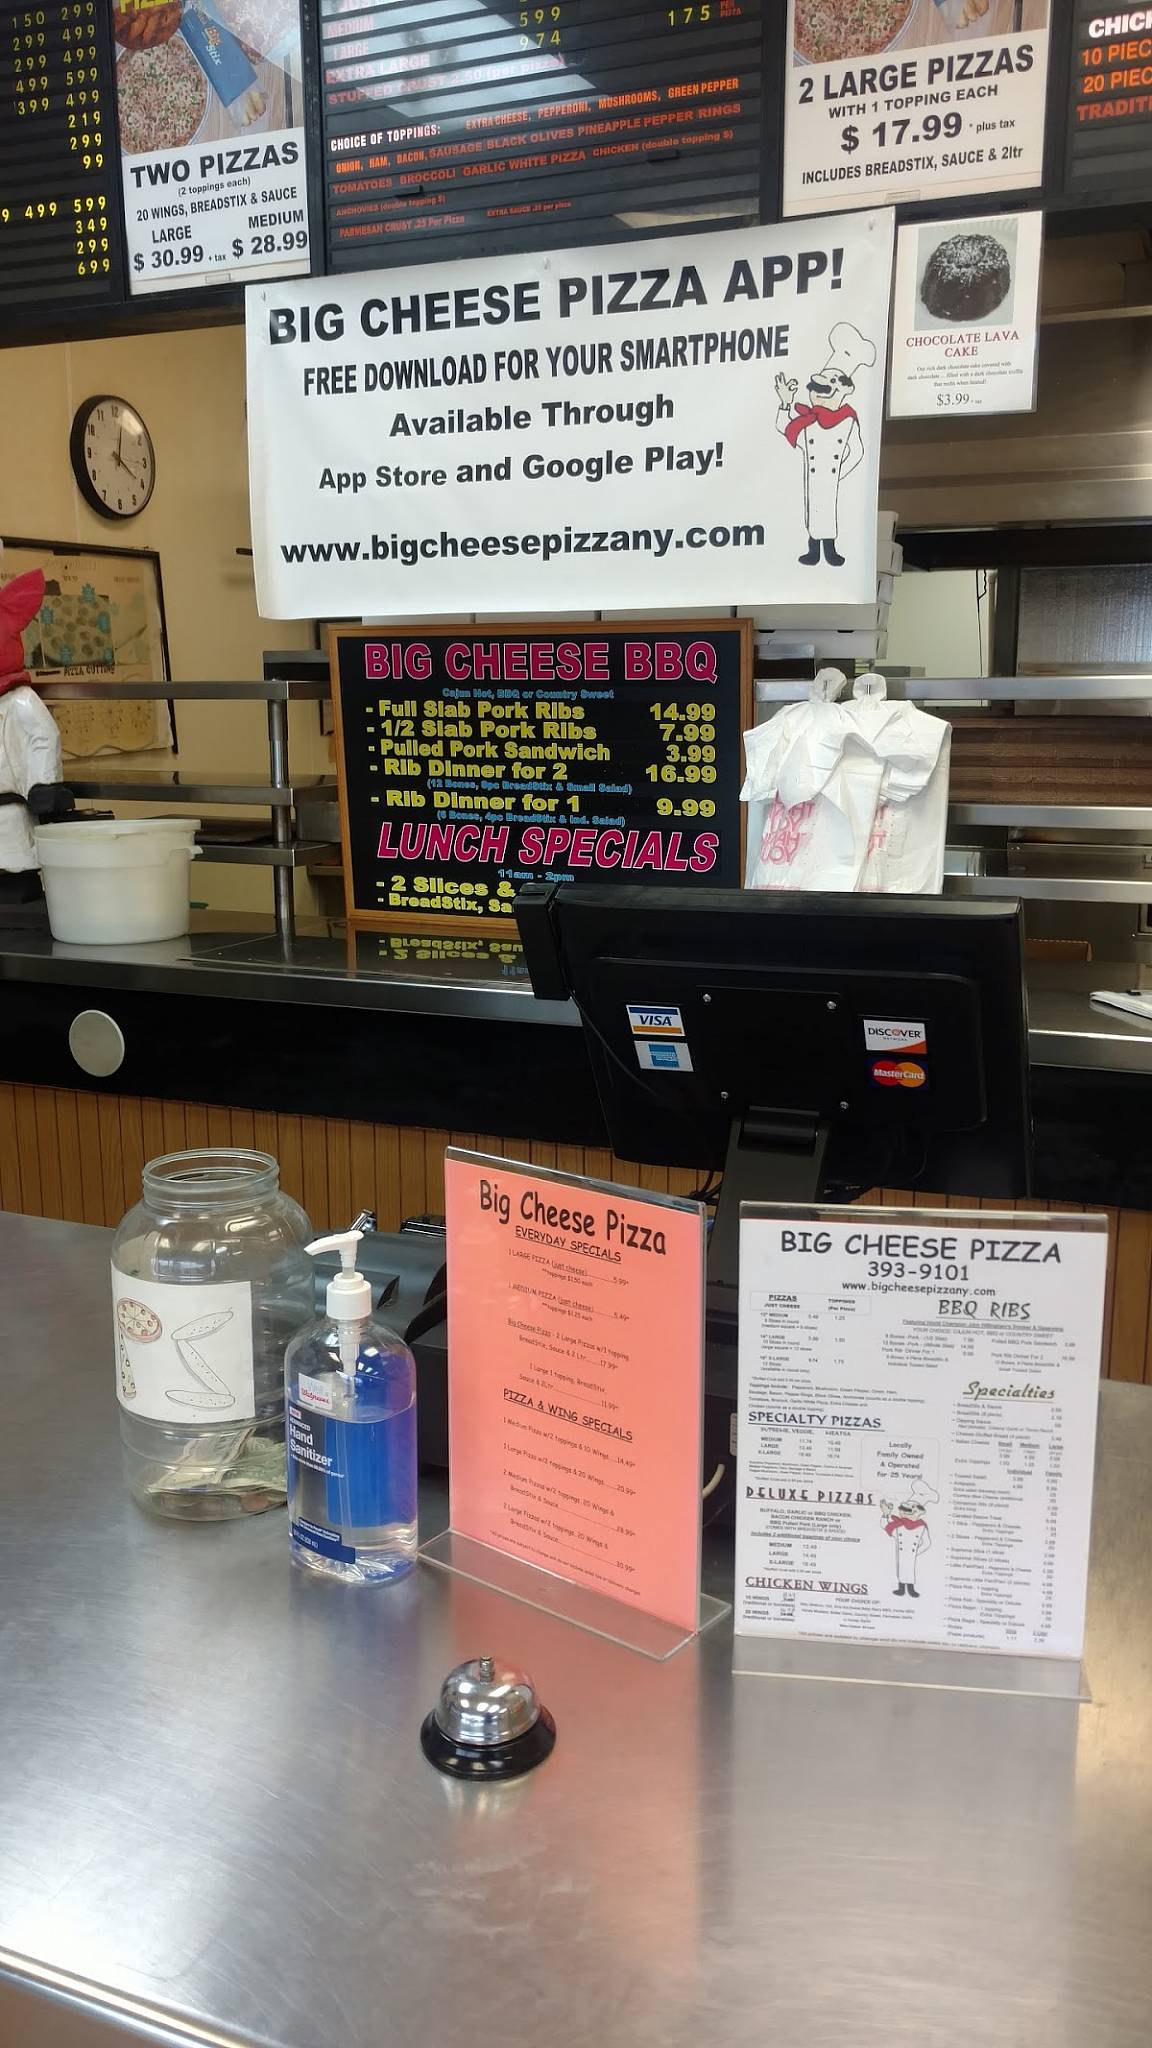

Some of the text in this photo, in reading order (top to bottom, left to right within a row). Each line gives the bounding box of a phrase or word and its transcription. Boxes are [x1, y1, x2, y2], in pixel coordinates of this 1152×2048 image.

[520, 5, 710, 27] 599 175
[64, 47, 96, 64] 499
[1083, 47, 1102, 66] 10
[66, 68, 98, 86] 599
[799, 44, 1034, 104] 2 LARGE PIZZAS
[1083, 75, 1105, 93] 20
[829, 84, 998, 119] WITH 1 TOPPING EACH
[68, 111, 101, 128] 219
[331, 78, 739, 151] CHOICE OF TOPPINGS: EXTRA GREEN PEPPER
[428, 103, 741, 158] SAUSAGE BLACK OLIVES PINEAPPLE PEPPER RINGS
[872, 112, 1016, 148] 17.99 plus tax
[70, 133, 102, 150] 299
[130, 141, 299, 188] TWO PIZZAS
[332, 132, 720, 194] TOMATOES BROCCOLI GARLIC WHITE PIZZA CHICKEN topping
[802, 149, 984, 185] INCLUDES BREADSTIX, SAUCE
[188, 176, 251, 196] toppings each)
[73, 196, 106, 213] 599
[136, 187, 297, 222] 20 WINGS, BREADSTIX & SAUCE
[76, 218, 107, 234] 349
[152, 209, 304, 244] LARGE MEDIUM
[151, 230, 308, 268] 30.99 tax 28.99
[78, 259, 110, 275] 699
[269, 248, 844, 345] BIG CHEESE PIZZA APP!
[906, 330, 1019, 348] CHOCOLATE LAVA
[304, 325, 790, 396] FREE DOWNLOAD FOR YOUR SMARTPHONE
[944, 346, 978, 358] CAKE
[936, 393, 970, 406] $3.99
[389, 394, 674, 438] Available Through
[318, 442, 724, 494] App Store and Google Play!
[281, 523, 765, 566] www.bigcheesepizzany.com
[365, 641, 718, 684] BIG CHEESE BBQ
[442, 688, 614, 700] Cajun BBQ Country Sweet
[378, 700, 716, 721] Full Slab Pork Ribs 14.99
[381, 719, 716, 742] 1/2 Slab Pork Ribs 7.99
[380, 738, 716, 763] Pulled Pork Sandwich 3.99
[384, 758, 717, 783] Rib Dinner for 2 16.99
[386, 789, 716, 817] Rib Dinner for 1 9.99
[377, 822, 719, 873] LUNCH SPECIALS
[391, 875, 488, 896] 2 Slices
[498, 869, 575, 882] 11am 2pm
[389, 893, 483, 913] BreadStix,
[638, 1015, 672, 1026] VISA
[868, 1027, 922, 1039] DISCOVER
[873, 1068, 925, 1081] MasterCard
[479, 1179, 666, 1255] Big Cheese Pizza
[515, 1225, 622, 1262] EVERYDAY SPECIALS
[780, 1231, 1062, 1263] BIG CHEESE PIZZA
[867, 1261, 969, 1281] 393-9101
[842, 1281, 996, 1298] www.bigcheesepizzany.com
[938, 1300, 1031, 1320] BBQ RIBS
[301, 1387, 330, 1404] Walgreens
[963, 1381, 1056, 1400] Specialties
[503, 1388, 633, 1441] PIZZA WING SPECIALS
[748, 1411, 881, 1428] SPECIALTY PIZZAS
[289, 1424, 313, 1446] Hand
[290, 1438, 332, 1467] Sanitizer
[877, 1451, 898, 1459] Family
[888, 1461, 920, 1469] Operated
[746, 1486, 873, 1505] DELUXE PIZZAS
[745, 1576, 868, 1595] CHICKEN WINGS
